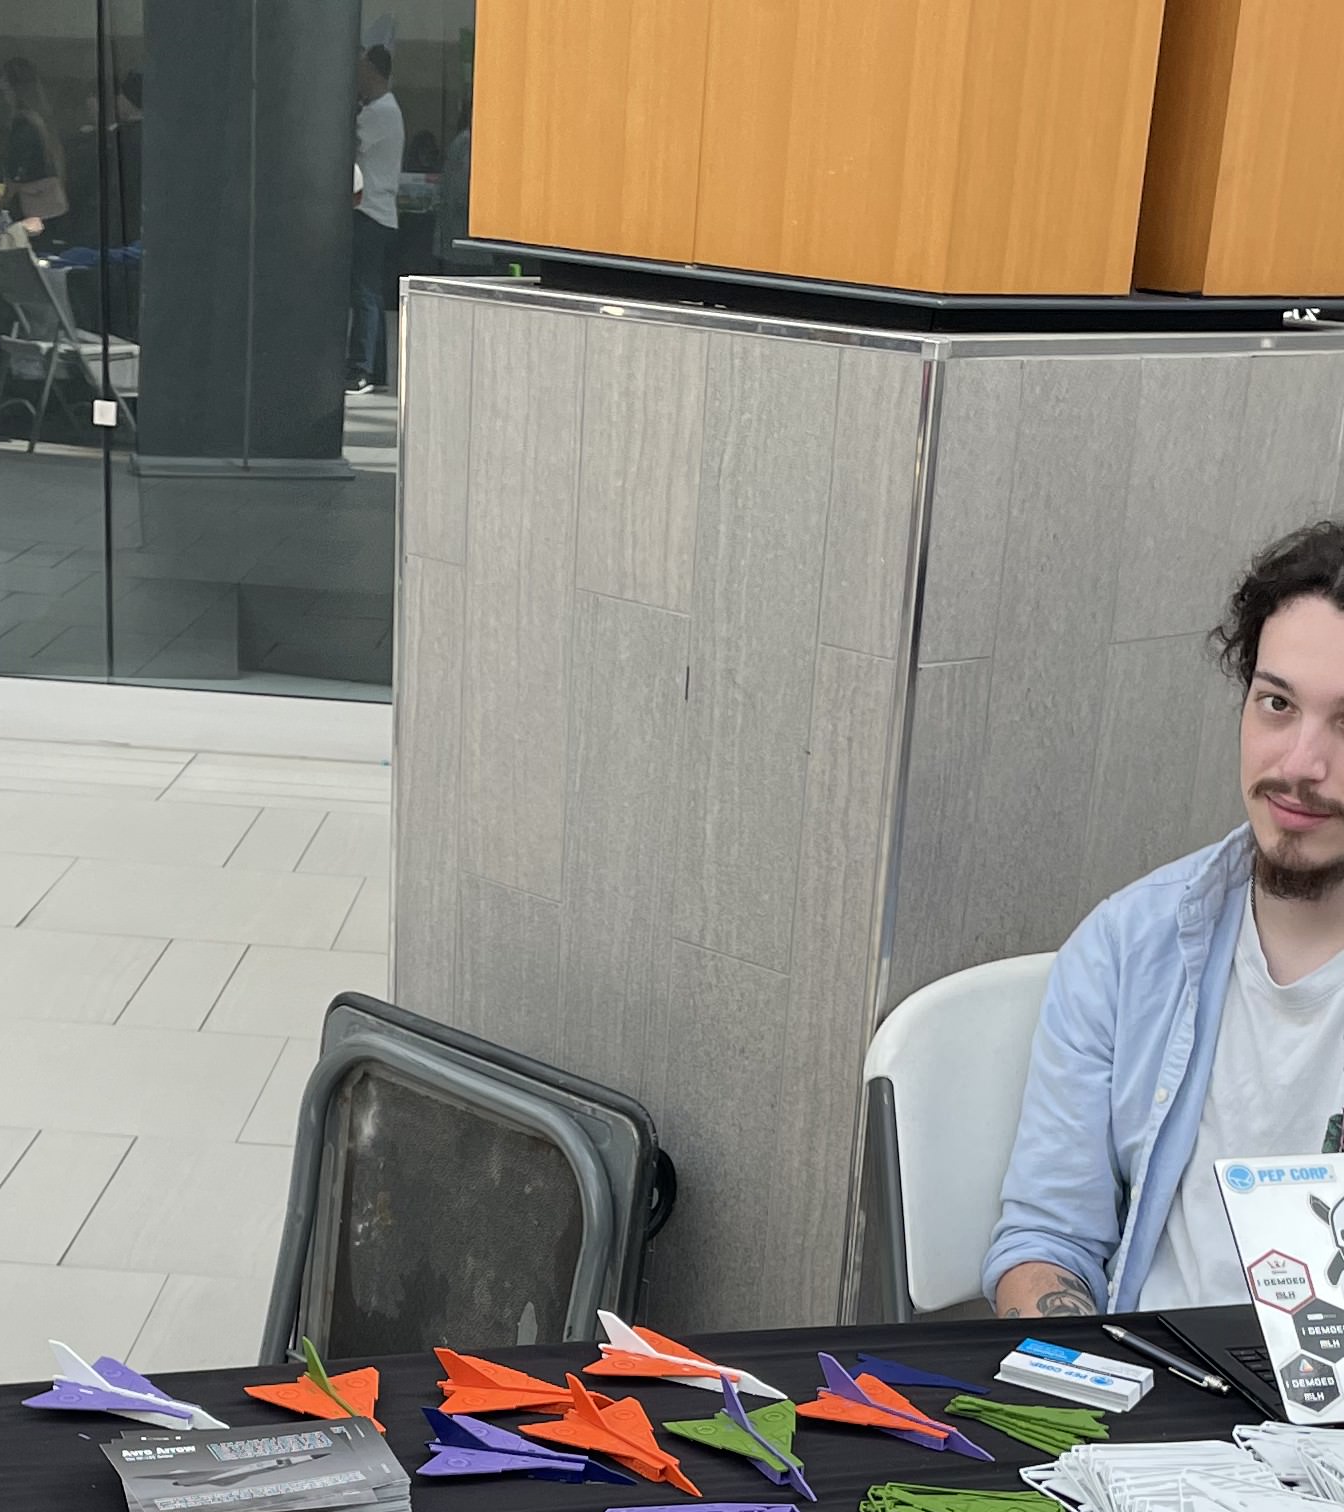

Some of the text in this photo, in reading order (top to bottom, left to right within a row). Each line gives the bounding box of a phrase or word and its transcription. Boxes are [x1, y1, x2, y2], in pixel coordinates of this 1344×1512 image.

[1257, 1166, 1334, 1183] PEP CORP.
[1263, 1276, 1307, 1287] DEMOED
[1292, 1376, 1335, 1388] DEMOED
